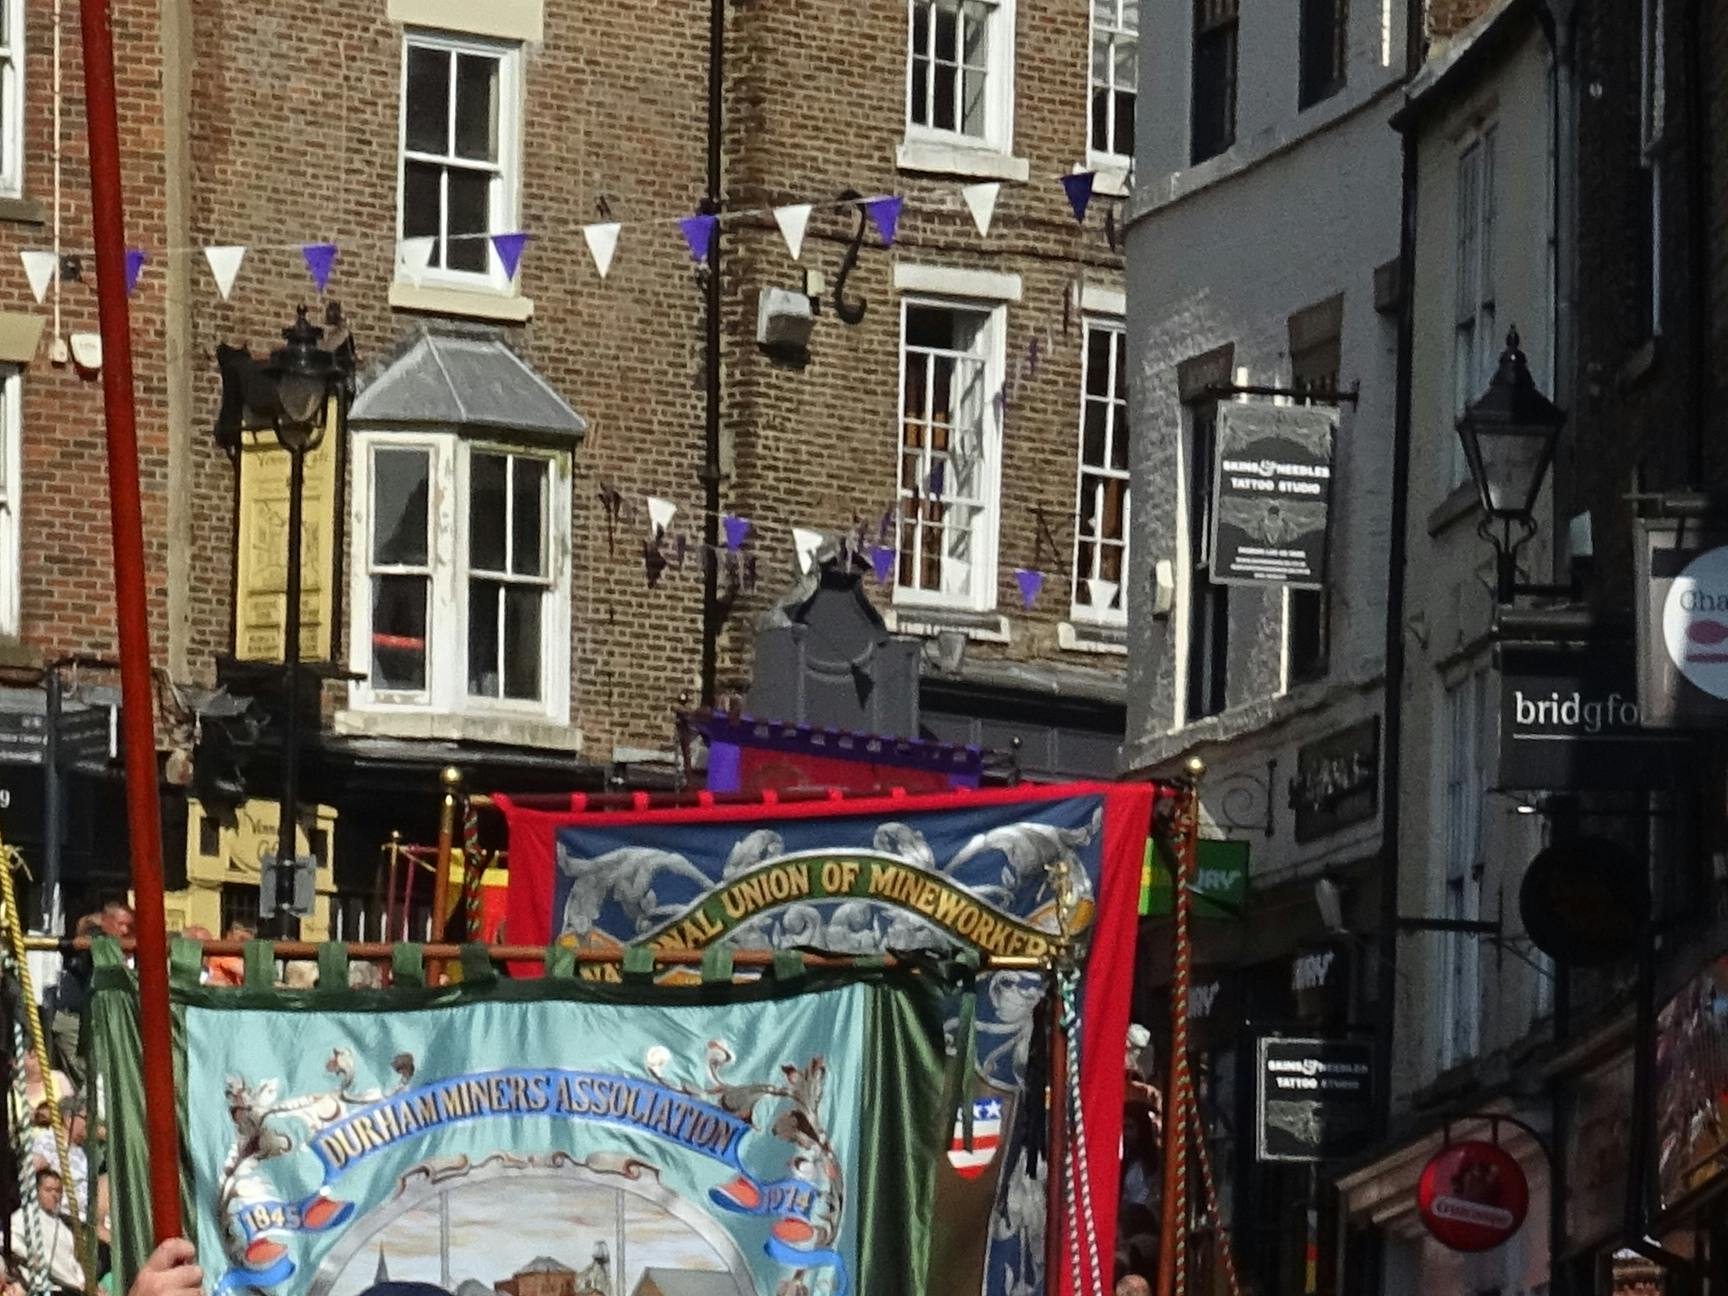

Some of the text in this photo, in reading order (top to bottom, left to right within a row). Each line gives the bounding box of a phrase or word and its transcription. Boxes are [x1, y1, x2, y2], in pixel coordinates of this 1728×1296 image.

[1230, 477, 1321, 495] TATTOO STUDIO
[1515, 690, 1643, 733] bridgfo
[724, 862, 811, 918] UNION
[821, 860, 859, 894] OF
[870, 863, 1051, 958] MINEWORKER
[320, 1092, 443, 1170] DURHAM
[442, 1075, 551, 1121] MINERS
[245, 1203, 302, 1232] 1845
